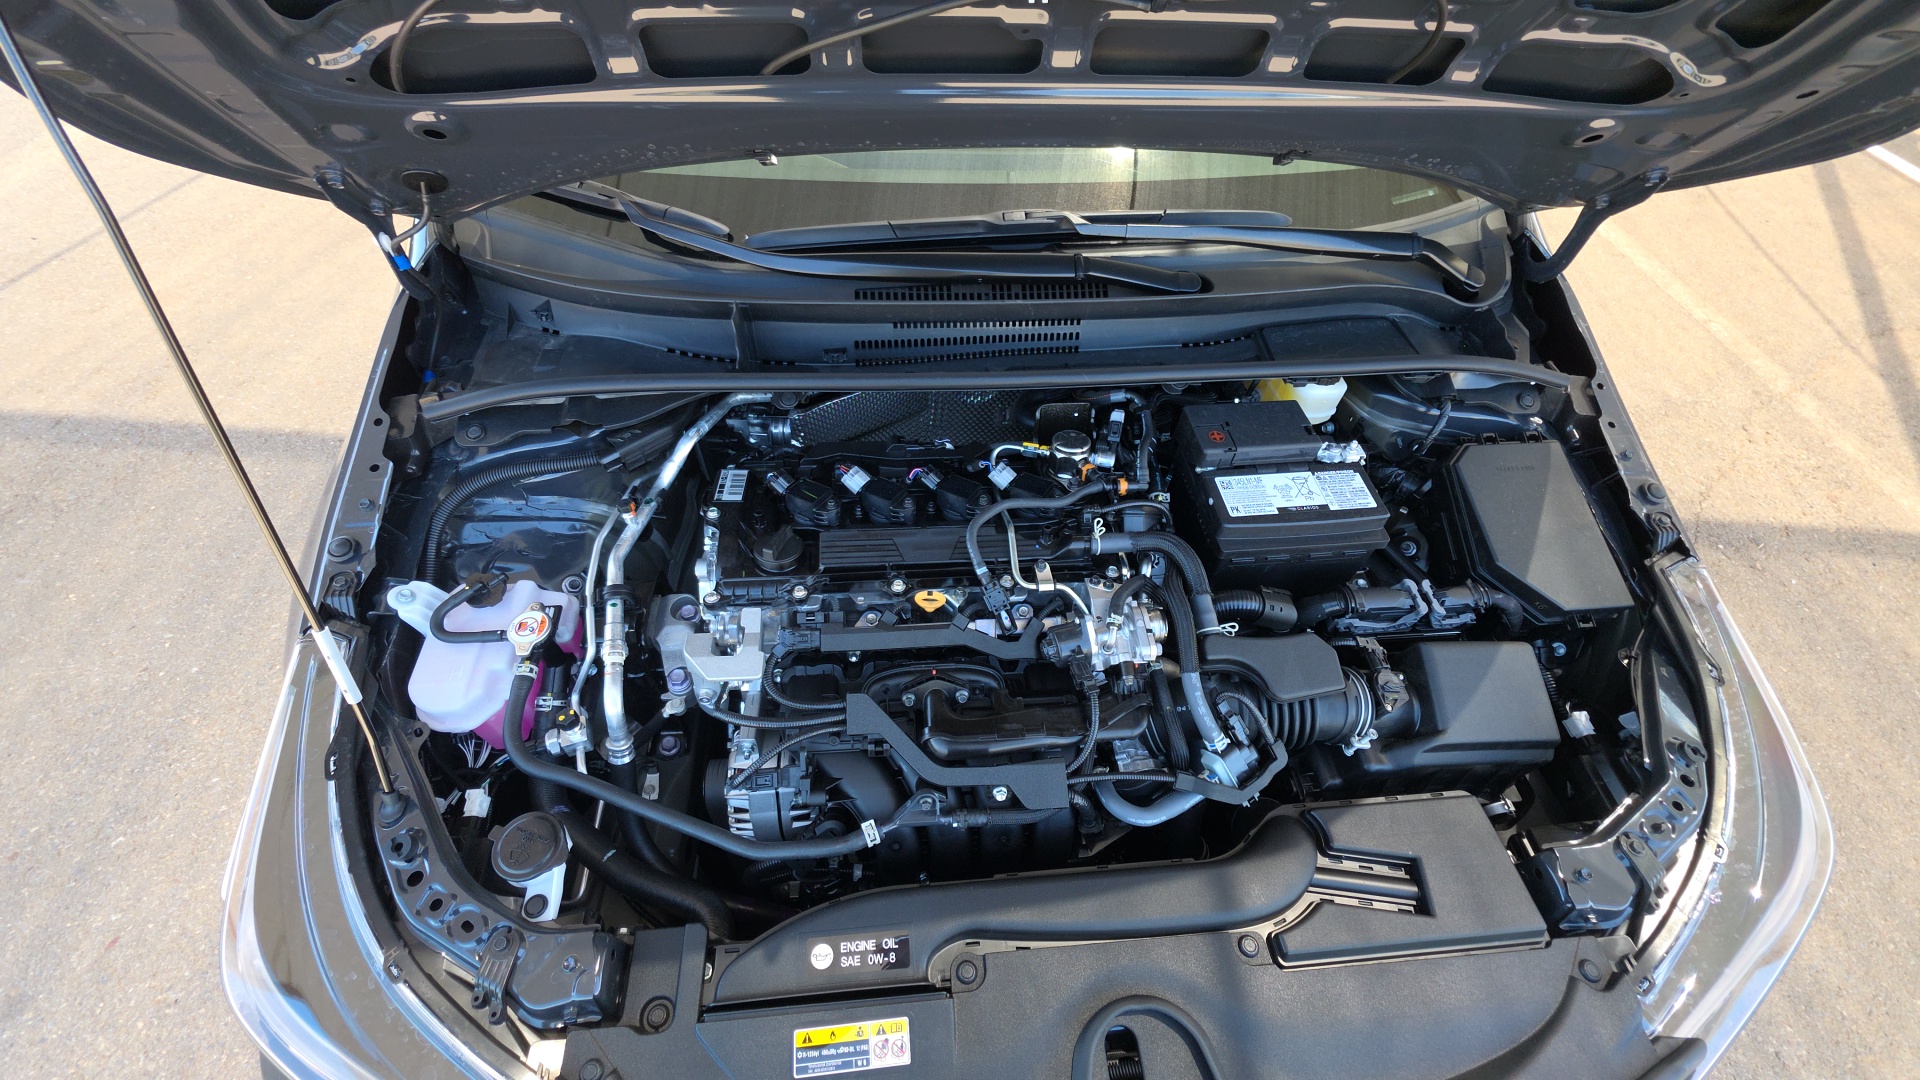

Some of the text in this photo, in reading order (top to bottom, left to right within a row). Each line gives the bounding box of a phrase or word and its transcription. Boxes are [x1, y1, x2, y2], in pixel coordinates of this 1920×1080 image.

[1229, 505, 1242, 514] PK
[840, 938, 898, 953] ENGINE OIL
[840, 952, 896, 968] SAE 0W-8
